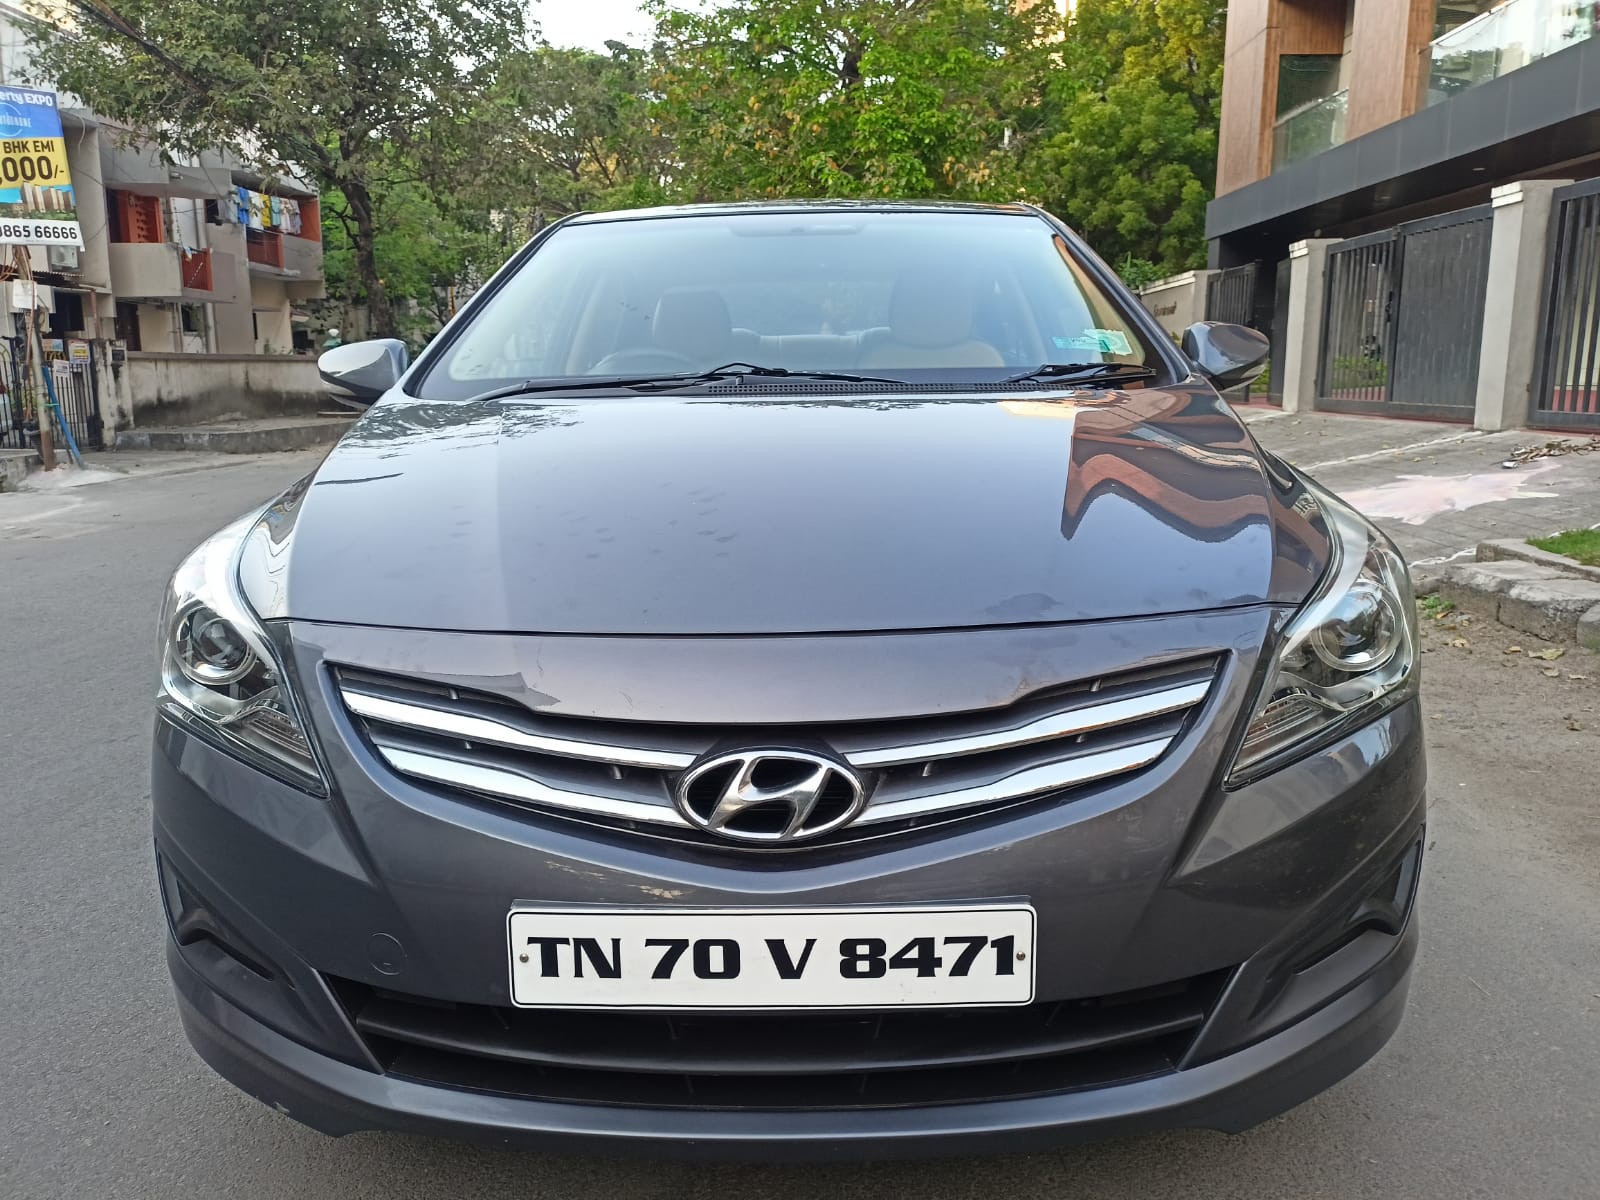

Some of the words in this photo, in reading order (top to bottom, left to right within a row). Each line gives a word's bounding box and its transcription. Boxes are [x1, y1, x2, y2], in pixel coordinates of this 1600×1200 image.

[23, 92, 53, 107] EXPO
[2, 140, 31, 154] BHK
[32, 140, 55, 153] EMI
[0, 224, 31, 238] 865
[34, 225, 78, 240] 66666
[527, 936, 623, 979] TN
[644, 938, 741, 980] 70
[764, 938, 818, 980] V
[839, 934, 1016, 979] 8471
